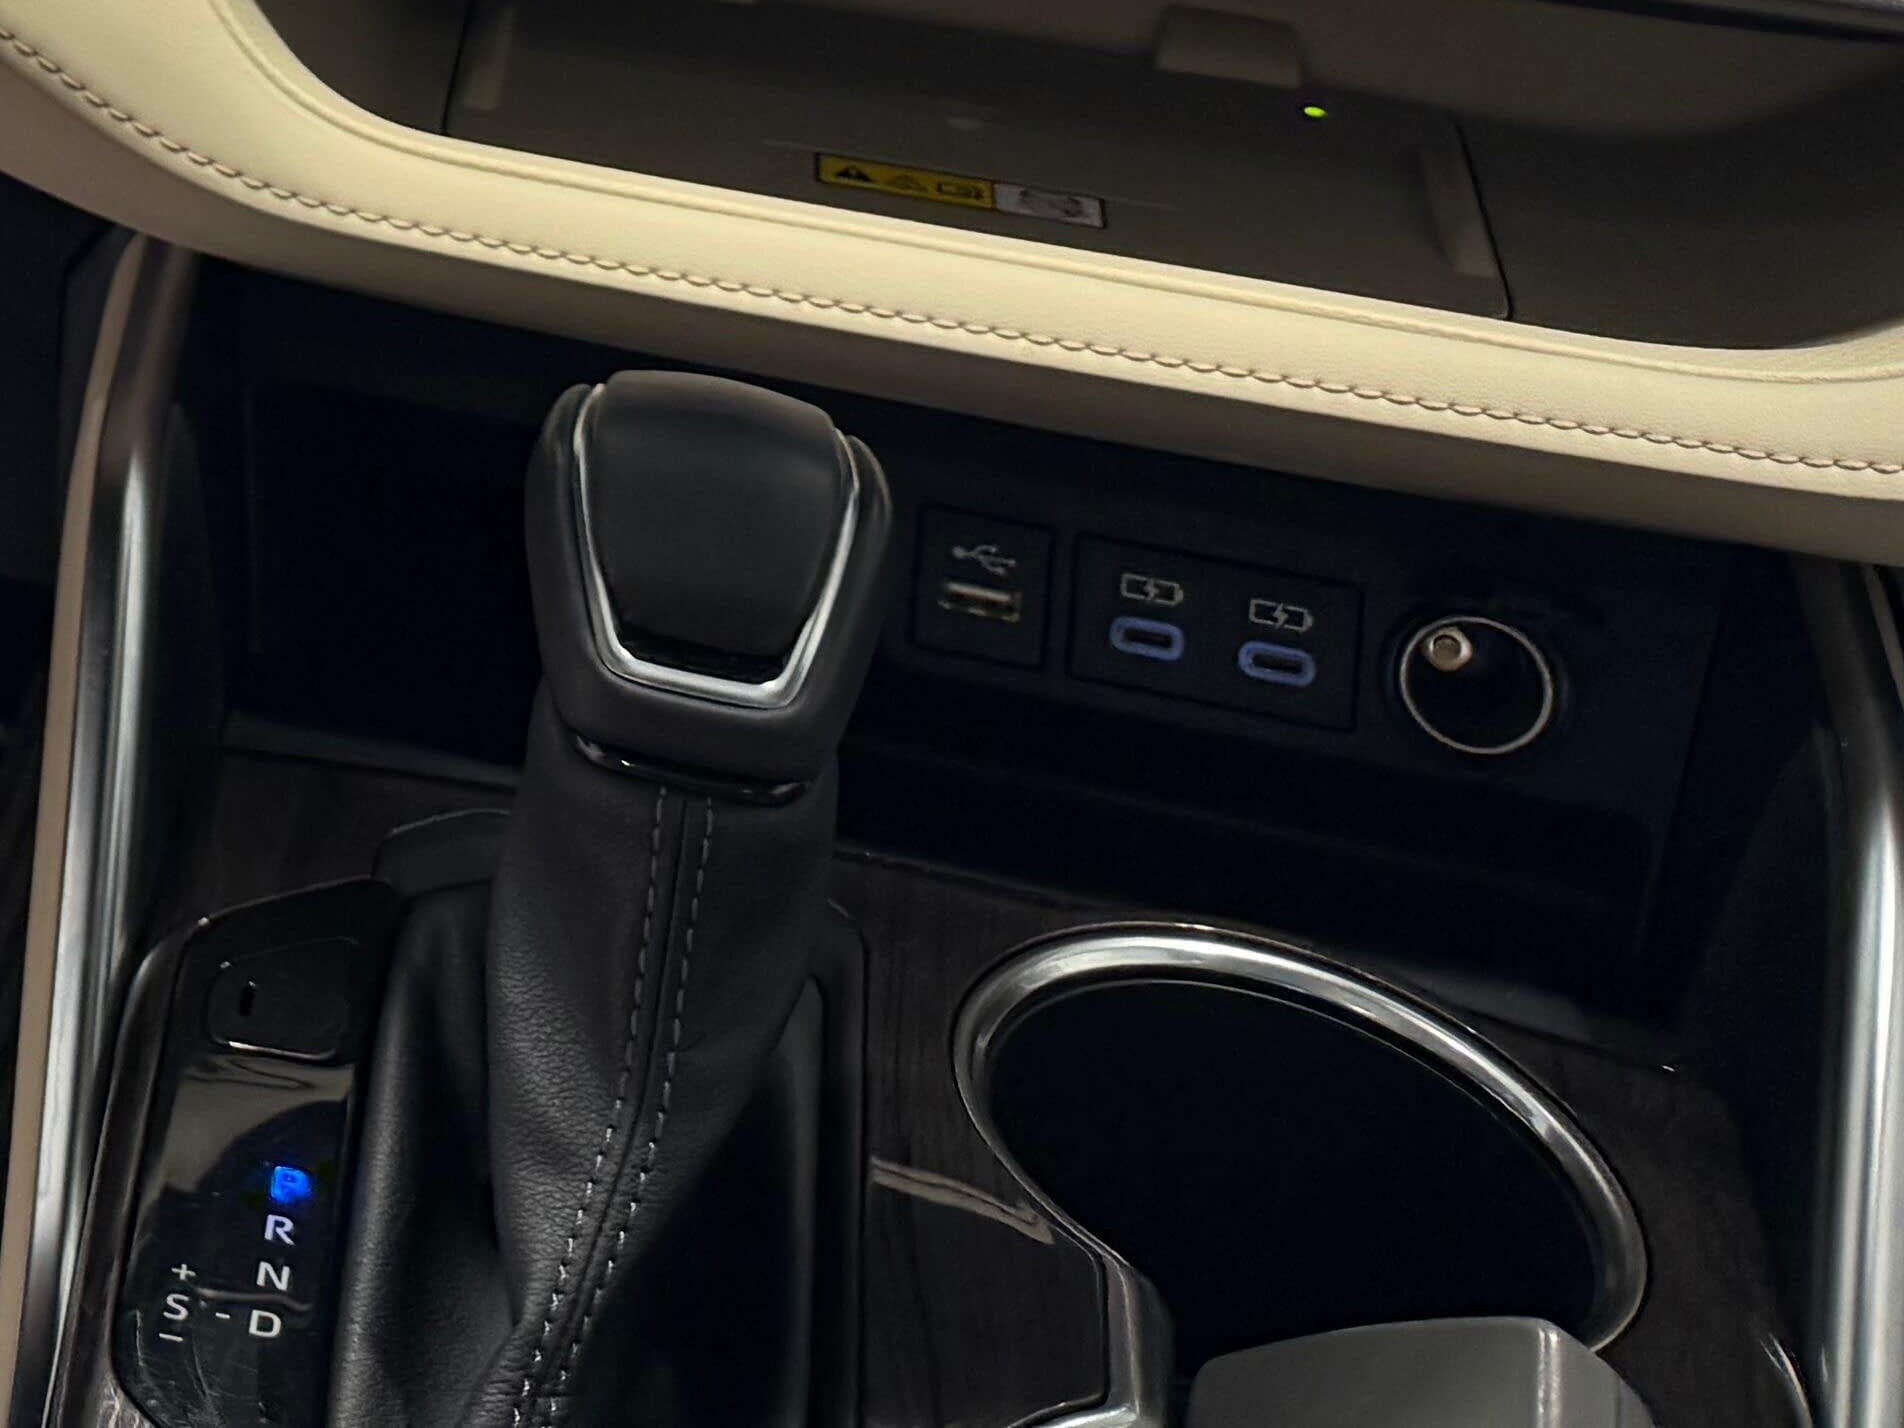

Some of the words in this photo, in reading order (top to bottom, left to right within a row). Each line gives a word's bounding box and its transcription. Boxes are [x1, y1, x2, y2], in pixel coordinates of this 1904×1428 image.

[269, 1165, 312, 1204] P
[264, 1213, 296, 1246] R
[256, 1260, 291, 1292] N
[162, 1293, 191, 1322] S
[248, 1309, 283, 1339] D
